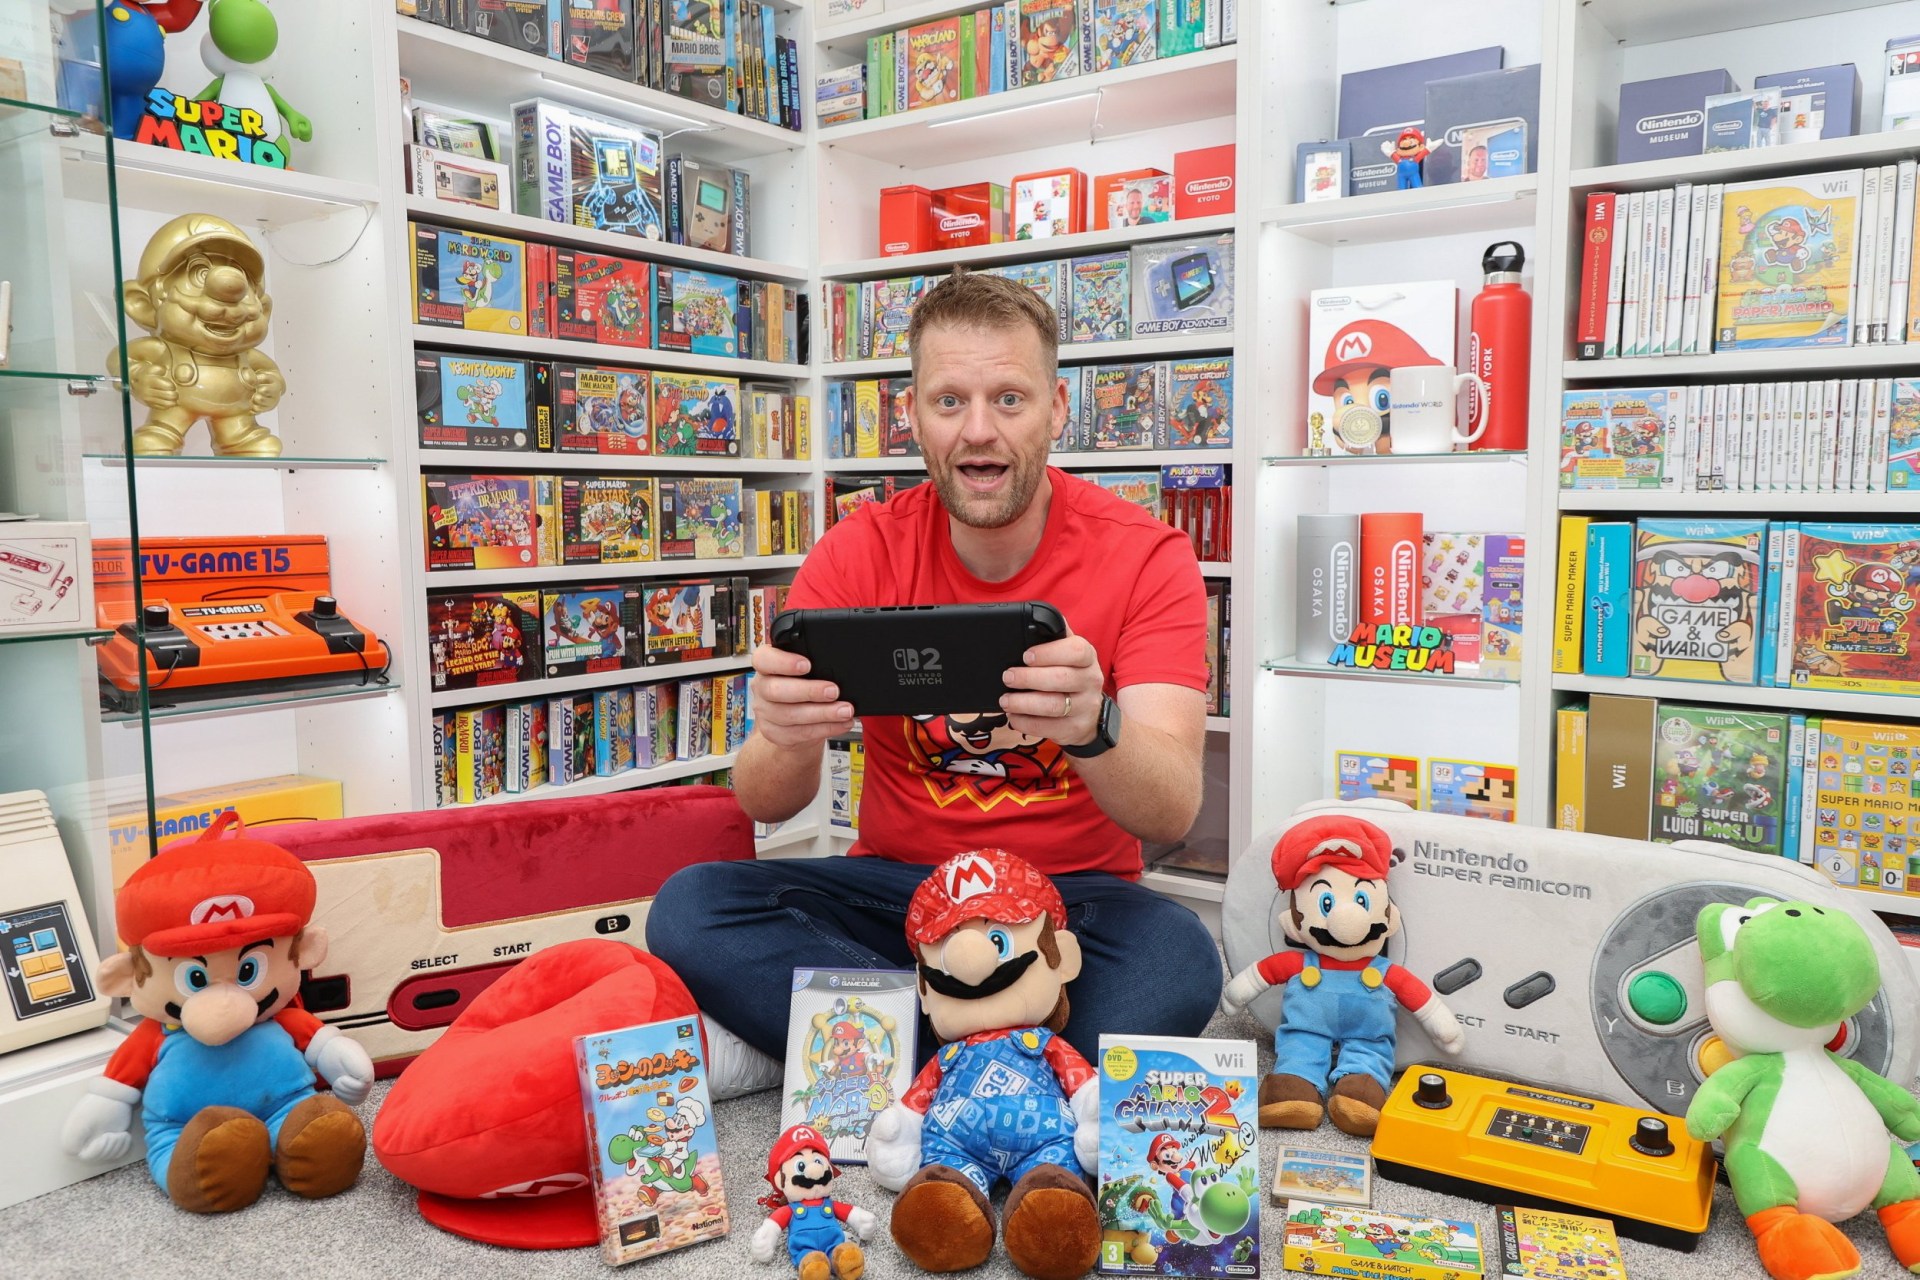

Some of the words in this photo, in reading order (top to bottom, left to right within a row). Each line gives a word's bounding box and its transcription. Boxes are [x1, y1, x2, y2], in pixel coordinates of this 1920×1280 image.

[671, 42, 697, 54] MARIO
[699, 44, 721, 55] BROS.
[779, 52, 787, 78] BROS.
[781, 79, 789, 106] MARIO
[145, 87, 267, 138] SUPER
[1642, 114, 1700, 129] Nintendo
[135, 114, 286, 169] MARIO
[546, 117, 563, 161] BOY
[1649, 132, 1689, 143] MUSEUM
[1352, 166, 1396, 178] Nintendo
[734, 172, 743, 203] LIGHT
[1189, 180, 1229, 192] Nintendo
[1358, 180, 1387, 189] MUSEUM
[1823, 181, 1848, 193] Wii
[1866, 177, 1876, 195] Wii
[1883, 175, 1893, 193] Wii
[1903, 173, 1912, 191] Wii
[548, 163, 565, 224] GAME
[1197, 195, 1221, 203] KYOTO
[1677, 194, 1687, 211] Wii
[1709, 193, 1719, 210] Wii
[1594, 202, 1606, 221] Wii
[1695, 195, 1705, 212] Wii
[470, 236, 491, 247] SUPER
[950, 231, 970, 239] KYOTO
[448, 241, 478, 257] MARIO
[479, 249, 512, 263] WORLD
[737, 233, 745, 258] AME
[1732, 304, 1781, 318] PAPER
[1784, 301, 1834, 315] MARIO
[1135, 322, 1163, 334] GAME
[1162, 320, 1180, 332] BOY
[1180, 318, 1227, 329] ADVANCE
[449, 362, 480, 376] YOSHI'S
[480, 364, 517, 379] COOKIE
[580, 374, 615, 383] MARIO'S
[1096, 372, 1126, 384] MARIO
[1178, 373, 1199, 381] SUPER
[592, 382, 614, 390] MACHINE
[585, 480, 606, 489] SUPER
[606, 480, 627, 489] MARIO
[93, 561, 123, 572] OLOR
[139, 551, 257, 577] TV-GAME
[264, 548, 291, 573] 15
[1568, 551, 1577, 580] MAKER
[1312, 567, 1323, 618] OSAKA
[1335, 550, 1349, 636] Nintendo
[1373, 566, 1385, 617] OSAKA
[1397, 549, 1412, 627] Nintend
[1566, 582, 1576, 611] MARIO
[200, 605, 250, 616] TV-GAME
[250, 603, 265, 613] 15
[1661, 609, 1728, 627] GAME
[1564, 612, 1573, 642] SUPER
[1687, 626, 1701, 641] &
[1843, 619, 1880, 632] マリオ
[648, 639, 659, 648] FUN
[660, 638, 674, 648] WITH
[674, 636, 696, 646] LETTERS
[1349, 622, 1443, 649] MARIO
[548, 650, 560, 660] FUN
[560, 649, 575, 659] WITH
[575, 646, 602, 657] NUMBERS
[1659, 640, 1725, 658] WARIO
[1832, 644, 1898, 653] みんなでミニランド
[445, 655, 473, 668] LEGEND
[474, 654, 483, 664] OF
[484, 650, 499, 662] THE
[923, 647, 943, 670] 2
[1327, 644, 1455, 674] MUSEUM
[452, 664, 476, 676] SEVEN
[476, 661, 496, 673] STARS
[898, 677, 943, 685] SWITCH
[522, 712, 530, 743] BOY
[563, 708, 572, 736] BOY
[433, 725, 443, 758] BOY
[473, 720, 482, 749] BOY
[522, 746, 530, 790] GAME
[564, 738, 573, 783] GAME
[435, 760, 444, 808] GAME
[474, 752, 482, 801] GAME
[1612, 764, 1627, 789] Wii
[1821, 794, 1860, 806] SUPER
[1864, 798, 1904, 811] MARIO
[1701, 808, 1748, 823] SUPER
[1662, 815, 1699, 836] LUIGI
[1745, 825, 1764, 844] U
[1413, 839, 1529, 873] Nintendo
[1413, 861, 1482, 884] SUPER
[1865, 867, 1875, 880] 3
[493, 942, 532, 957] START
[411, 954, 459, 970] SELECT
[1455, 1013, 1486, 1029] ECT
[1603, 1016, 1619, 1033] Y
[1504, 1023, 1560, 1045] START
[596, 1049, 701, 1087] ヨッシーのクッキー
[1215, 1053, 1244, 1069] Wii
[1145, 1070, 1208, 1088] SUPER
[1666, 1079, 1686, 1097] B
[1129, 1083, 1202, 1104] MARIO
[1528, 1092, 1580, 1107] TV-GAME
[1580, 1102, 1591, 1110] 6
[1113, 1098, 1207, 1125] GALAXY
[1199, 1086, 1241, 1130] 2
[692, 1215, 724, 1231] National
[1107, 1244, 1118, 1261] 3
[1331, 1266, 1359, 1277] MARIO
[1359, 1269, 1380, 1280] THE
[1350, 1259, 1377, 1269] GAME
[1383, 1263, 1412, 1273] WATCH
